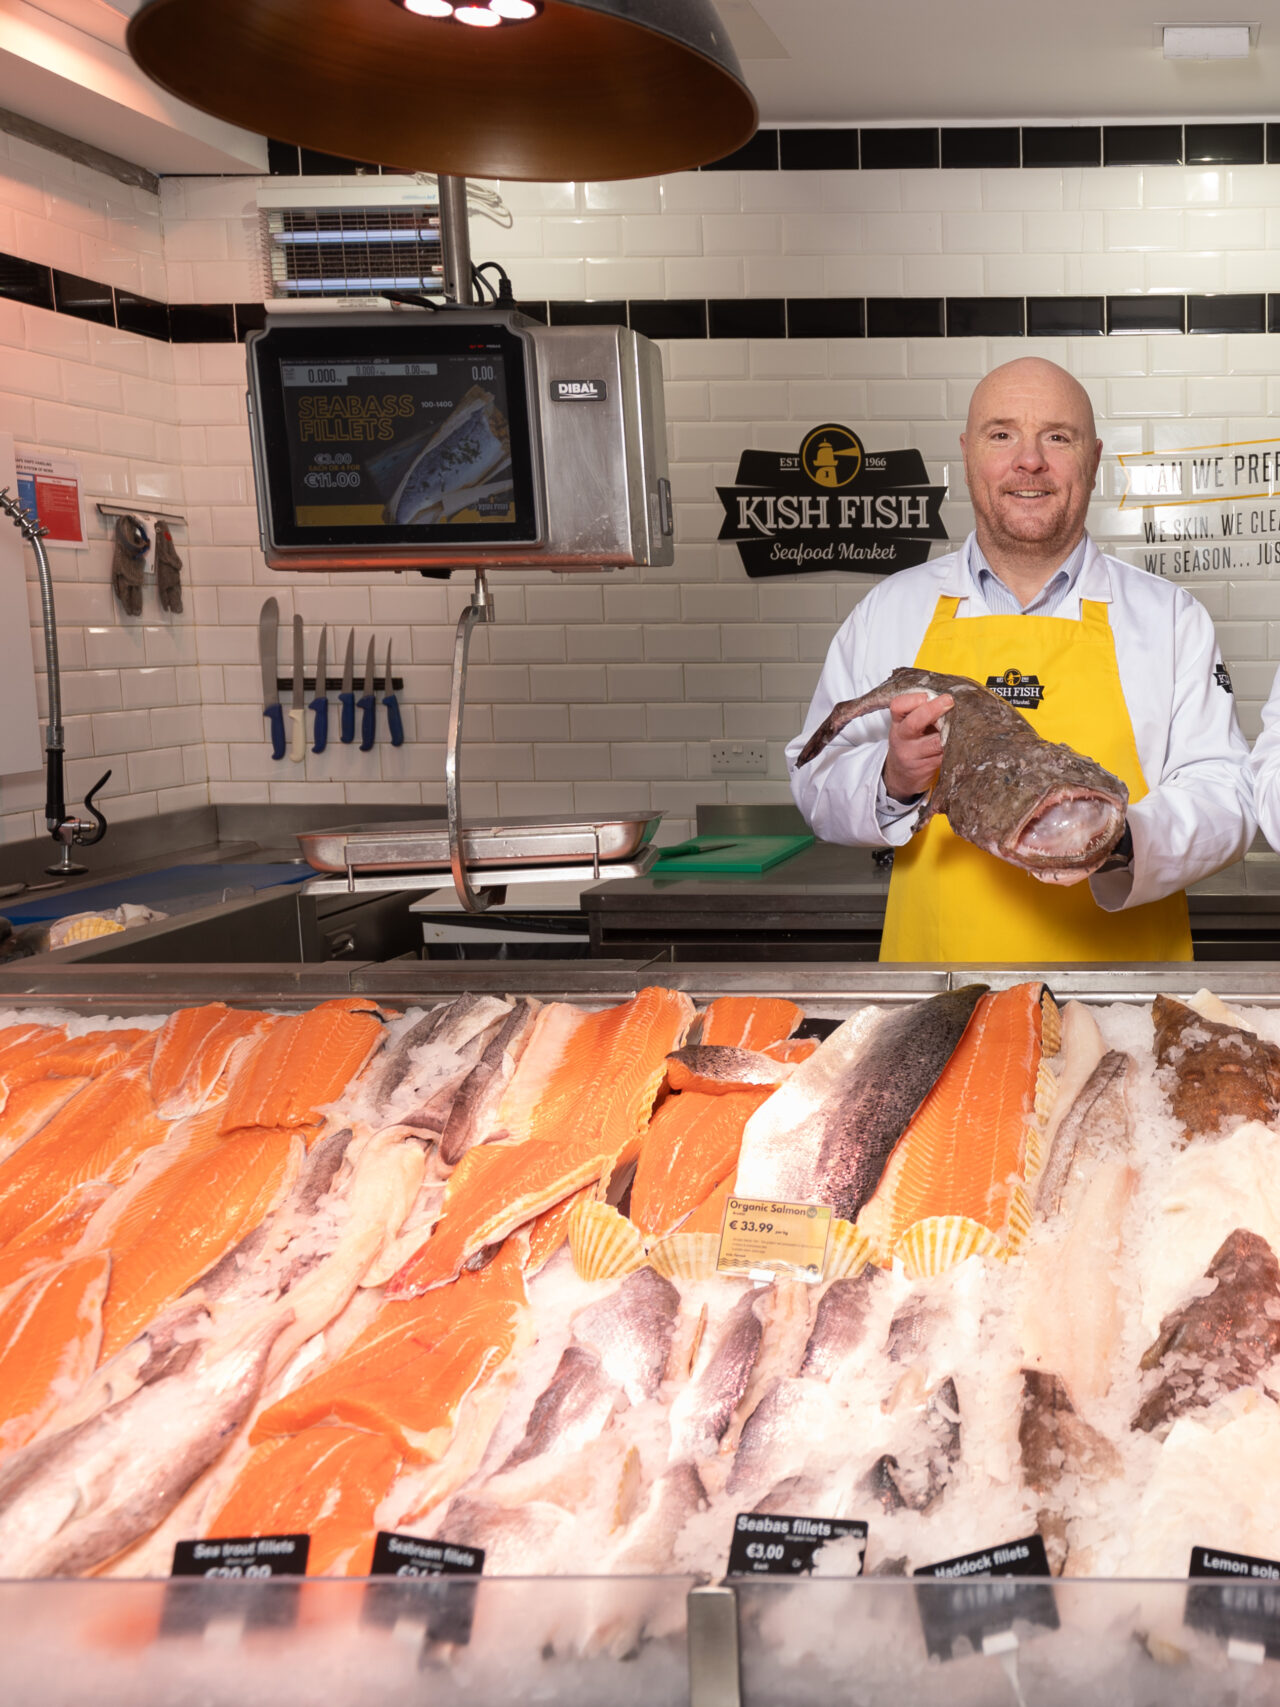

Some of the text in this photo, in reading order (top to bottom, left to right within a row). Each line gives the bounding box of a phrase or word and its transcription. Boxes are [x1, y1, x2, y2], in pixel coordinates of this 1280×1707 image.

[558, 383, 598, 394] DIBAL
[298, 394, 415, 418] SEABASS
[300, 418, 394, 442] FILLETS
[780, 457, 887, 467] EST 1966
[304, 472, 361, 488] €11.00
[1144, 461, 1182, 494] CAN
[1193, 456, 1224, 490] WE
[736, 496, 930, 536] KISH FISH
[1144, 520, 1168, 544] WE
[1174, 515, 1214, 541] SKIN,
[1221, 512, 1244, 536] WE
[770, 542, 897, 566] Seafood Market
[1144, 553, 1168, 576] WE
[1174, 546, 1250, 574] SEASON...
[989, 687, 1040, 697] ISH FISH
[730, 1200, 806, 1216] Organic Salmon
[729, 1220, 738, 1230] €
[740, 1221, 774, 1233] 33.99
[737, 1516, 790, 1534] Seabas
[792, 1519, 832, 1536] fillets
[193, 1539, 296, 1560] Sea trout fillets
[388, 1537, 443, 1560] Seabream
[444, 1547, 475, 1568] fillets
[746, 1542, 785, 1560] €3,00
[934, 1546, 1030, 1578] Haddock fillets
[1203, 1553, 1248, 1575] Lemon
[1252, 1564, 1280, 1580] sole
